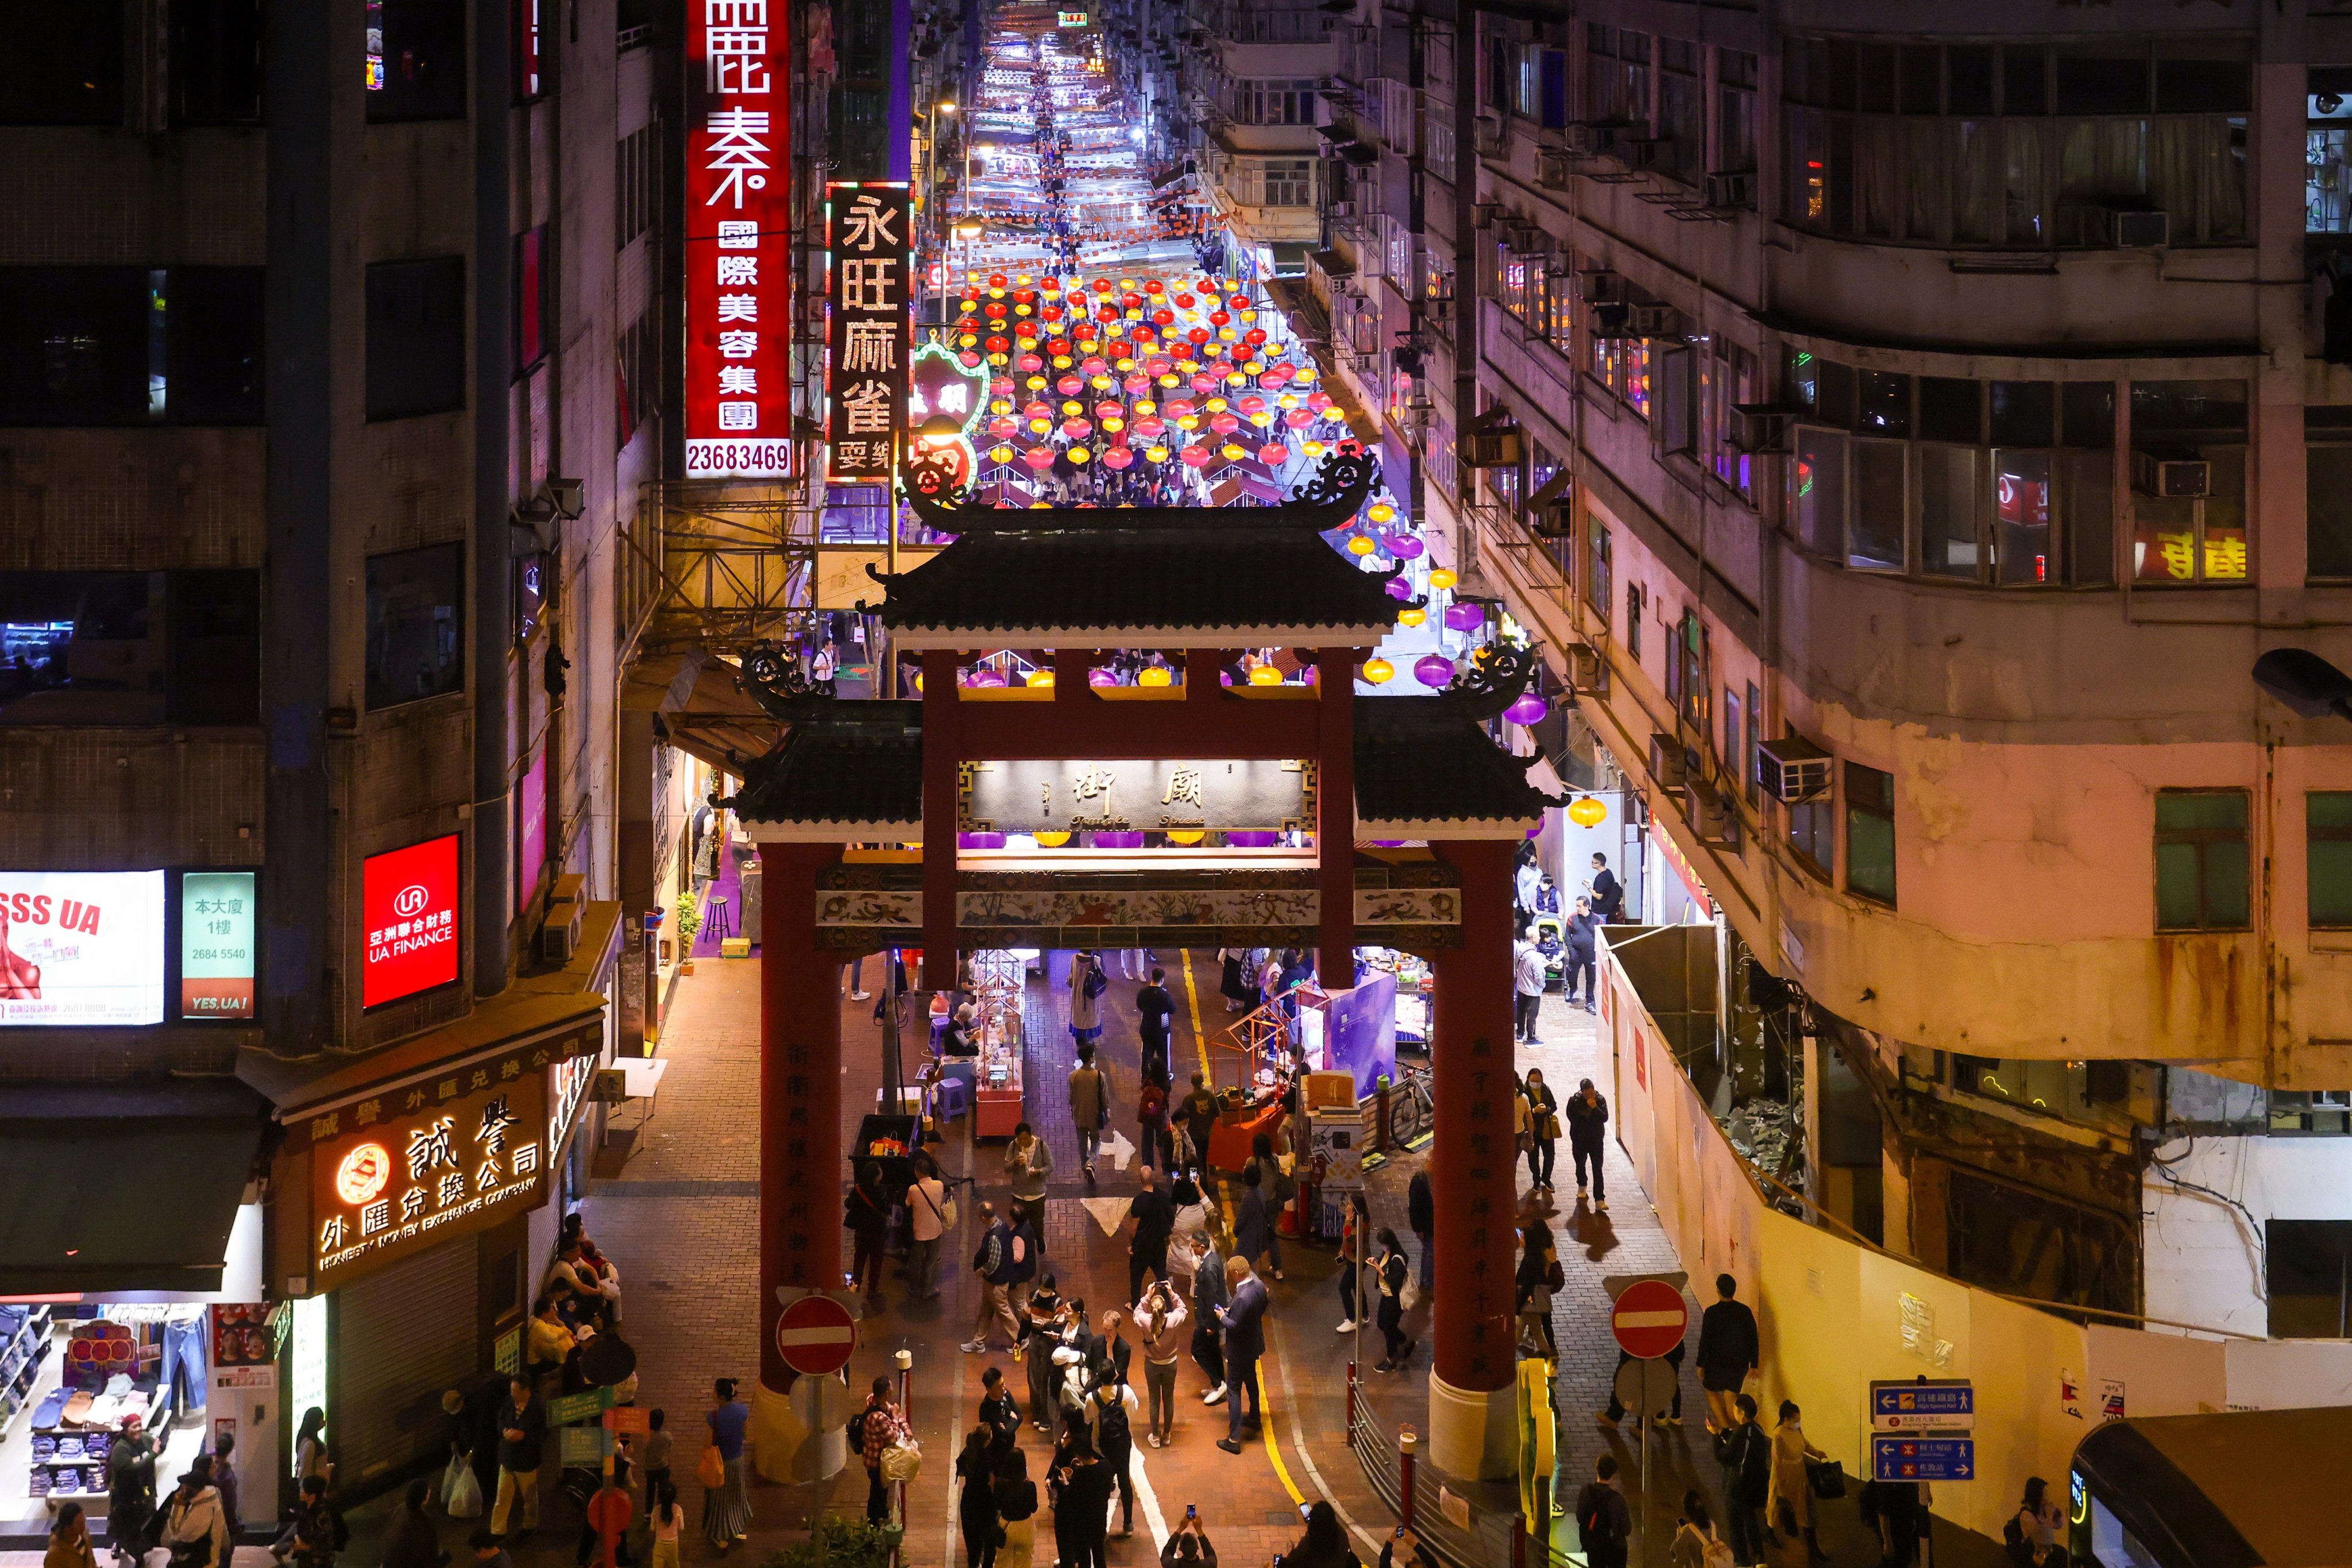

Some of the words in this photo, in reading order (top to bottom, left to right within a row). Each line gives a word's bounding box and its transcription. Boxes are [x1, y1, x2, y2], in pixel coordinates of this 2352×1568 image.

[842, 195, 899, 435] 永旺麻雀
[689, 445, 788, 471] 23683469
[1071, 814, 1130, 827] Temple
[1159, 815, 1204, 825] Street
[59, 899, 101, 936] UA
[195, 898, 242, 914] 本大廈
[207, 919, 231, 935] 1樓
[370, 910, 451, 947] 亞洲聯合財務
[192, 949, 217, 959] 2684
[221, 949, 245, 959] 5540
[369, 946, 390, 963] UA
[393, 926, 452, 956] FINANCE
[84, 1003, 106, 1013] 8888
[405, 1093, 522, 1180] 誠譽
[320, 1239, 374, 1272] HONESTY
[378, 1222, 419, 1249] MONEY
[423, 1197, 482, 1231] EXCHANGE
[485, 1177, 537, 1206] COMPANY
